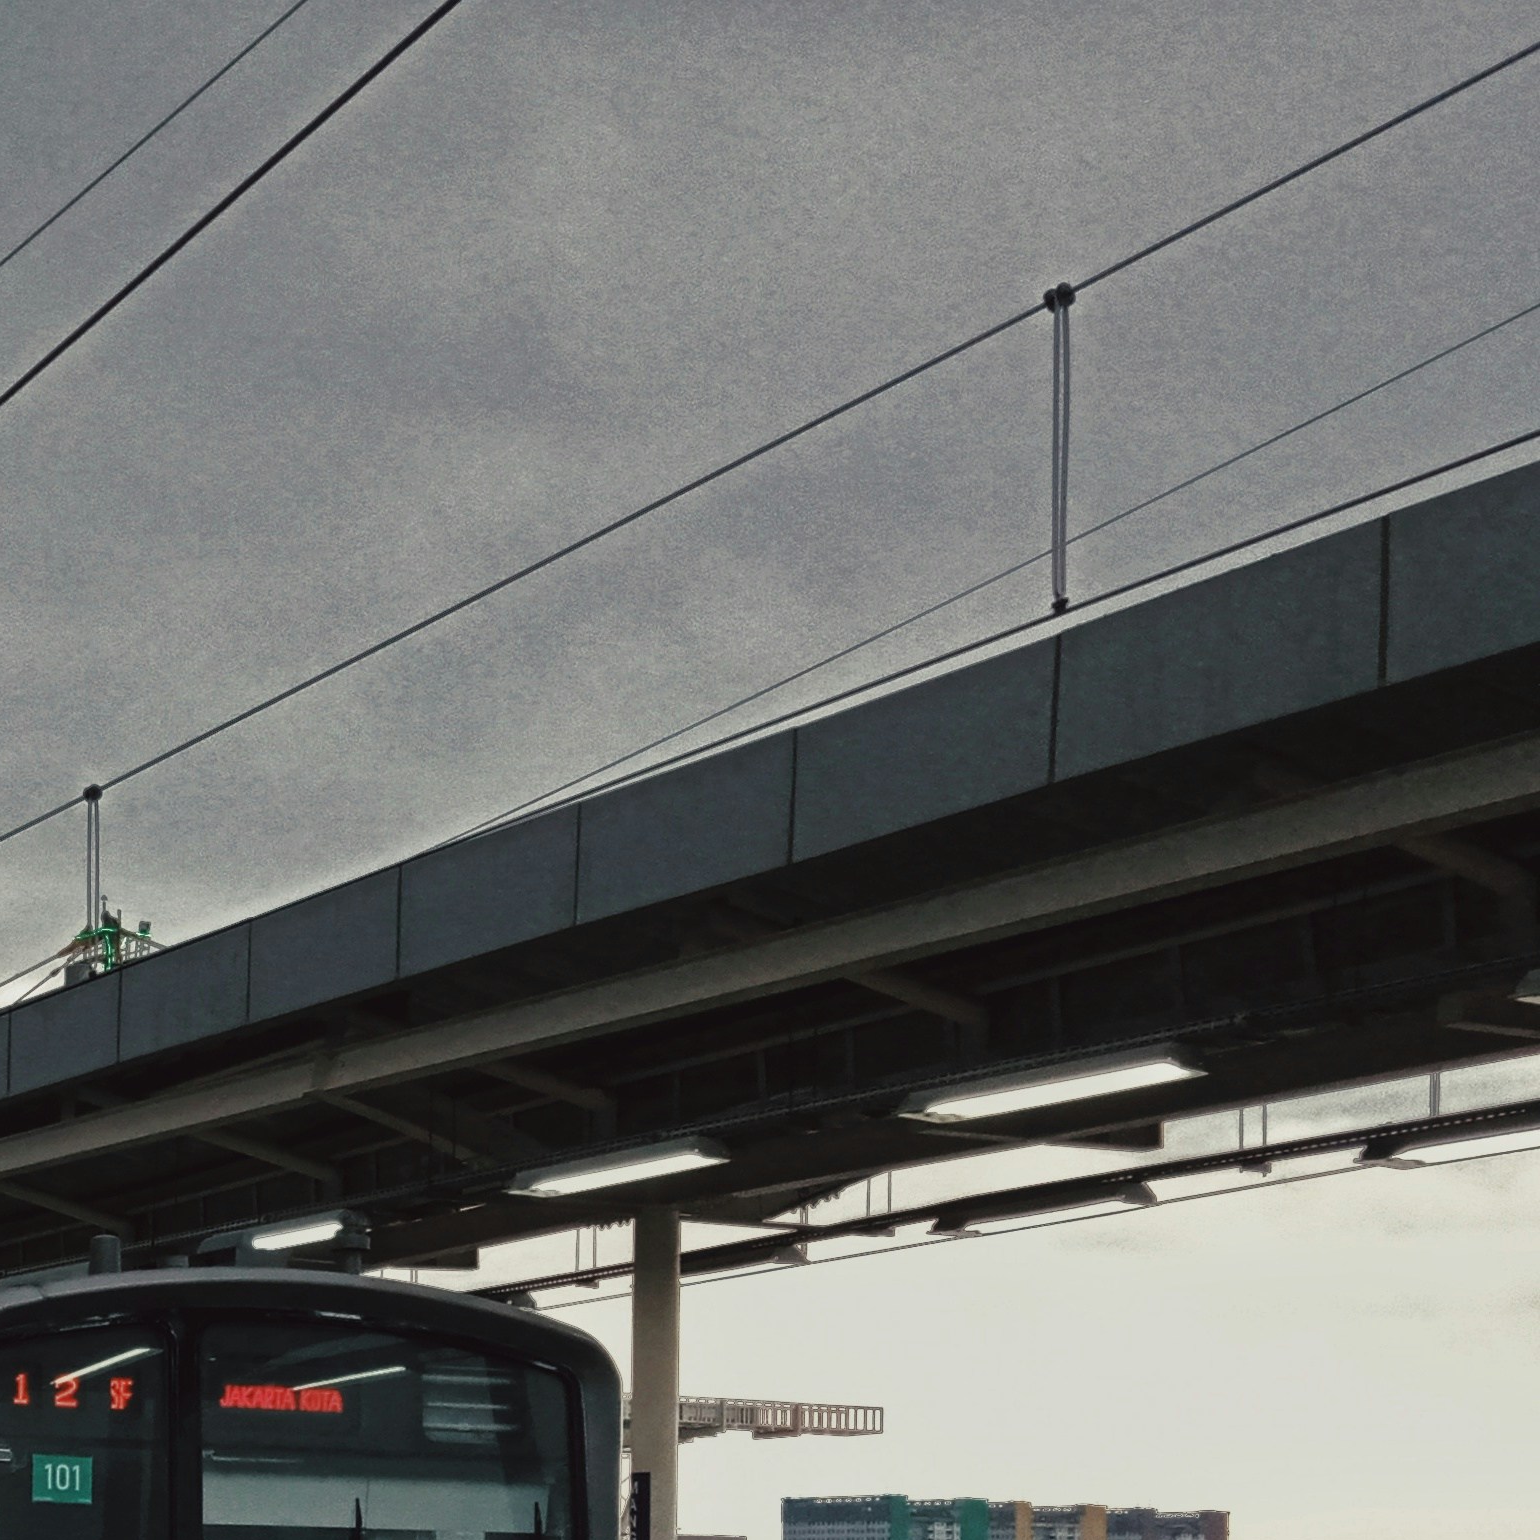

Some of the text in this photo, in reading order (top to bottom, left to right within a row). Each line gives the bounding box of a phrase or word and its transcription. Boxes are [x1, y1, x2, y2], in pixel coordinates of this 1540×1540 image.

[110, 1378, 134, 1410] SF
[220, 1384, 343, 1413] JAKARTA KOTA
[45, 1463, 81, 1491] 101
